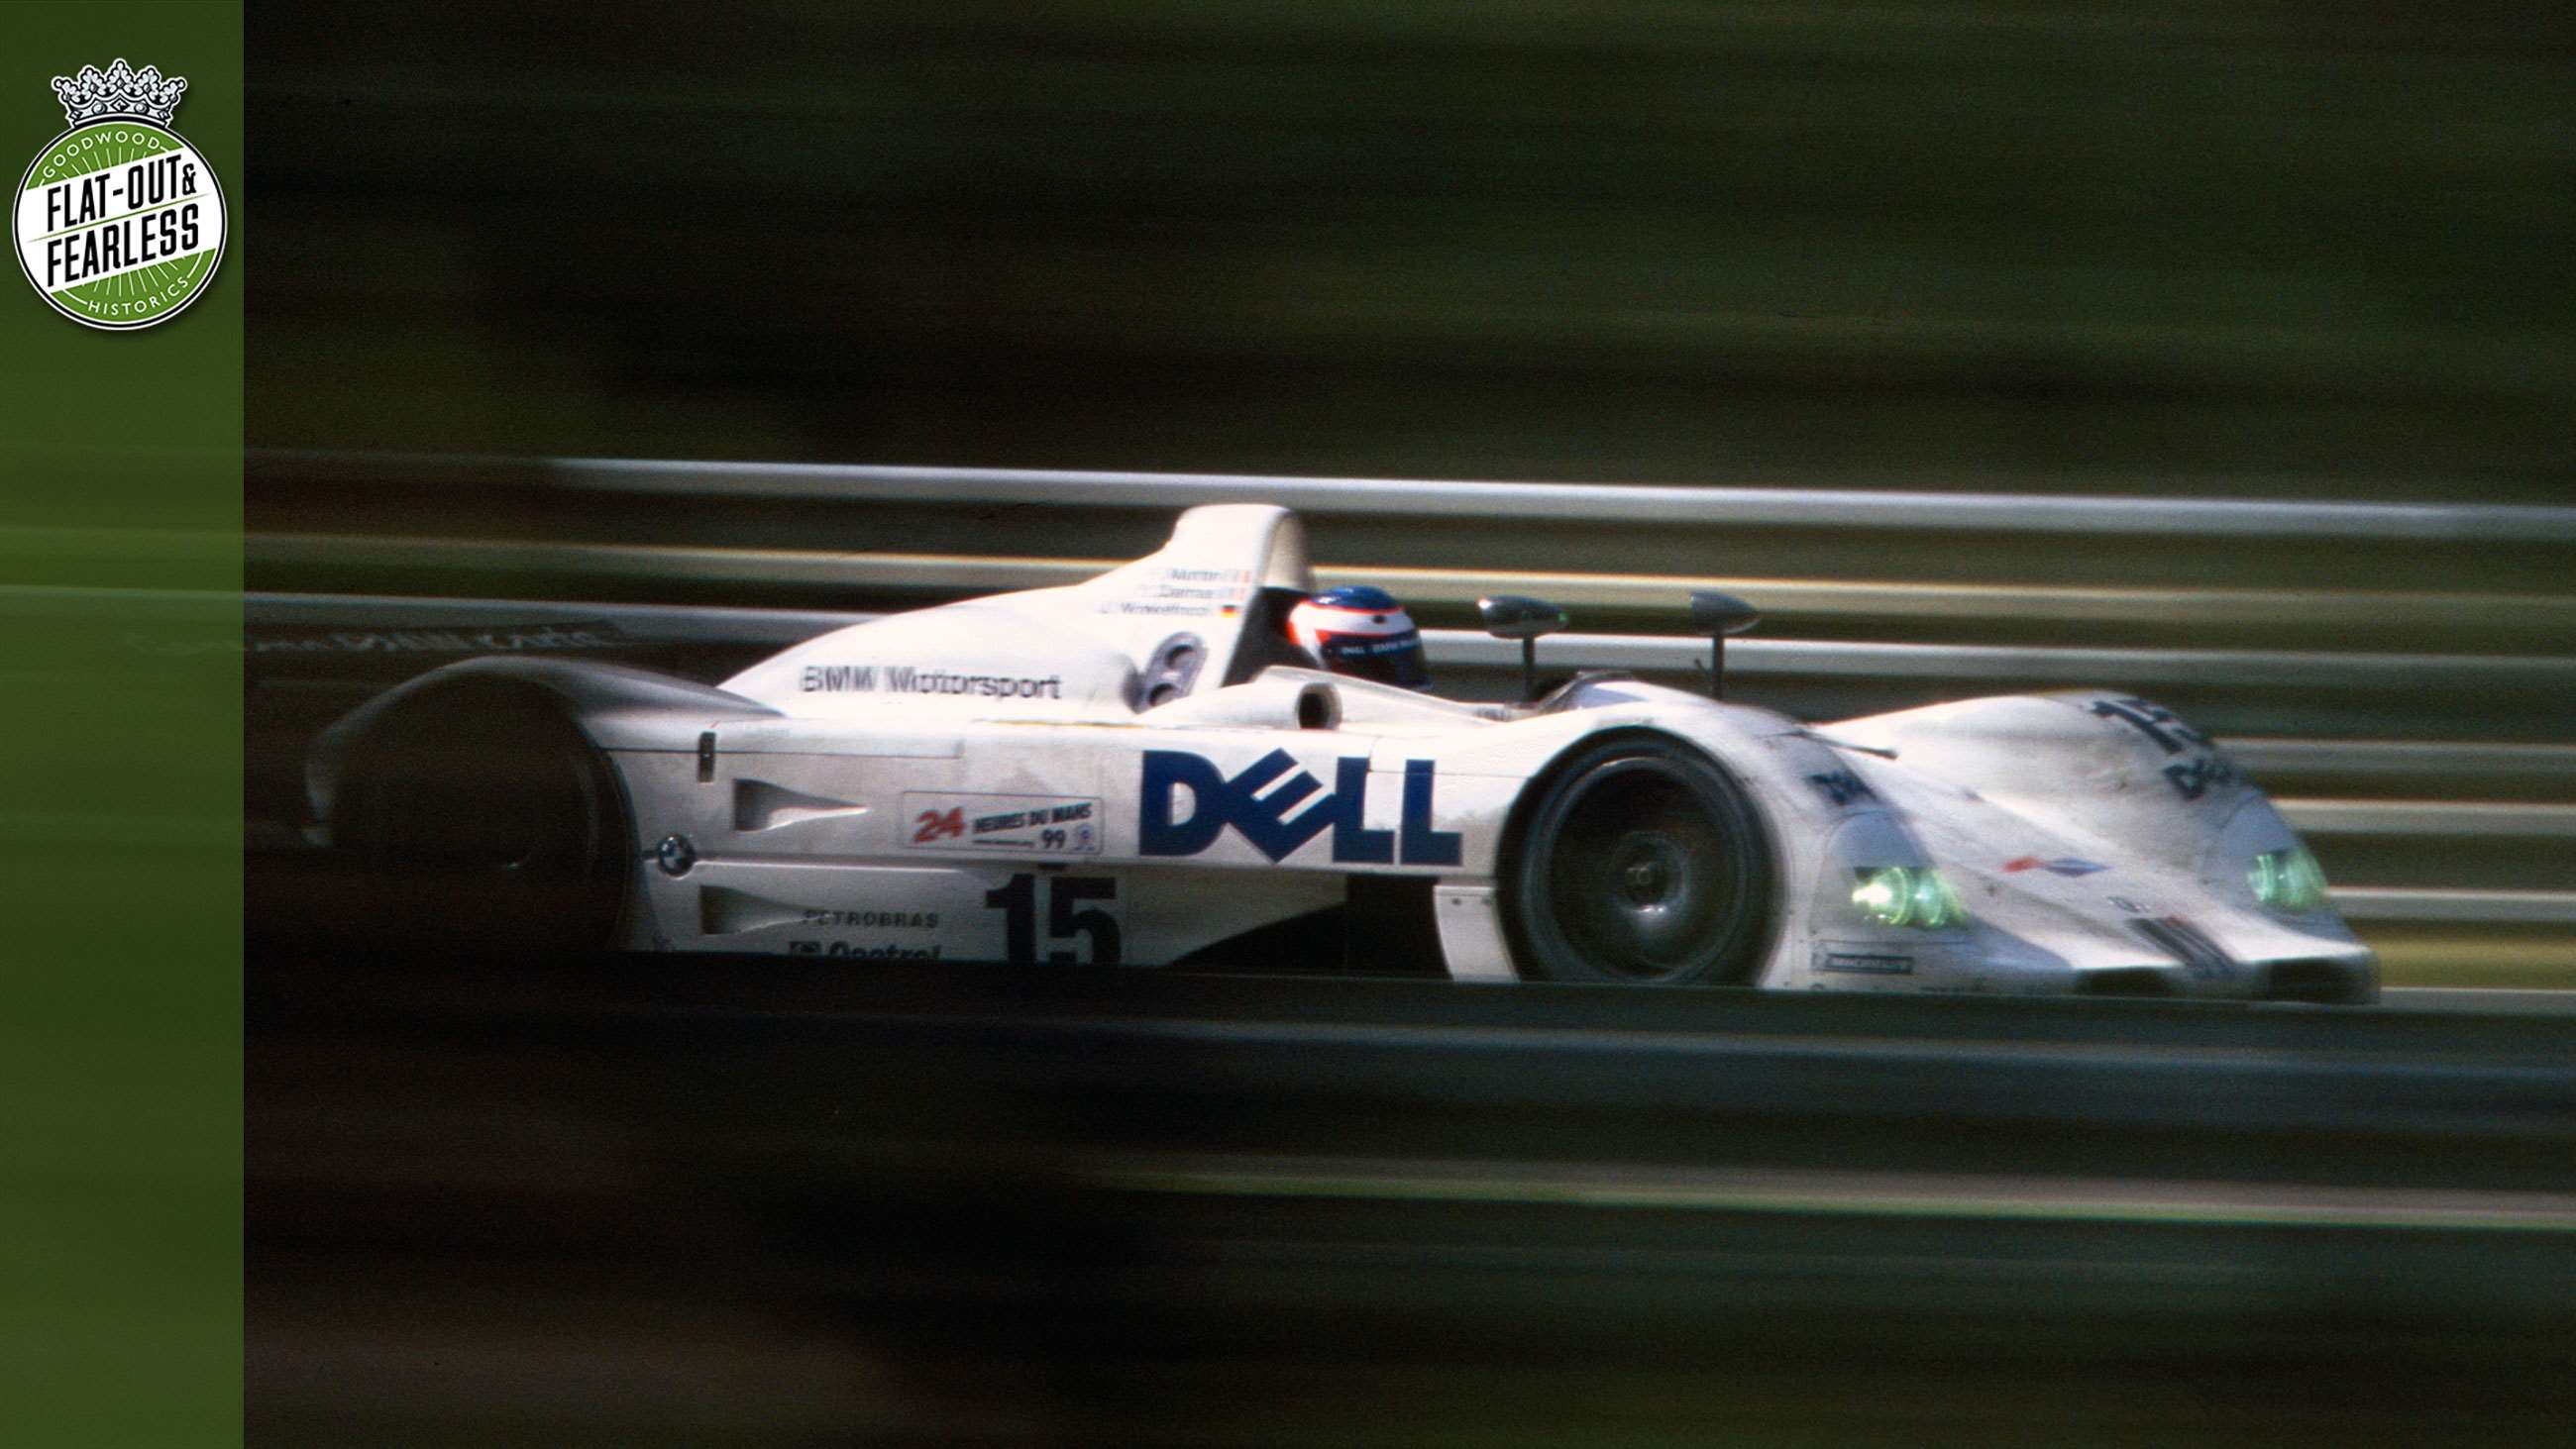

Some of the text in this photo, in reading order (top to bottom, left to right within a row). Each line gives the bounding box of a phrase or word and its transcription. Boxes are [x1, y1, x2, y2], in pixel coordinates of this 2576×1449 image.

[803, 666, 1062, 699] BMW Motorsport
[913, 805, 967, 843] 24
[1139, 748, 1463, 867] DELL
[1040, 828, 1066, 849] 99
[803, 910, 940, 928] PETROBRAS
[986, 874, 1122, 965] 15
